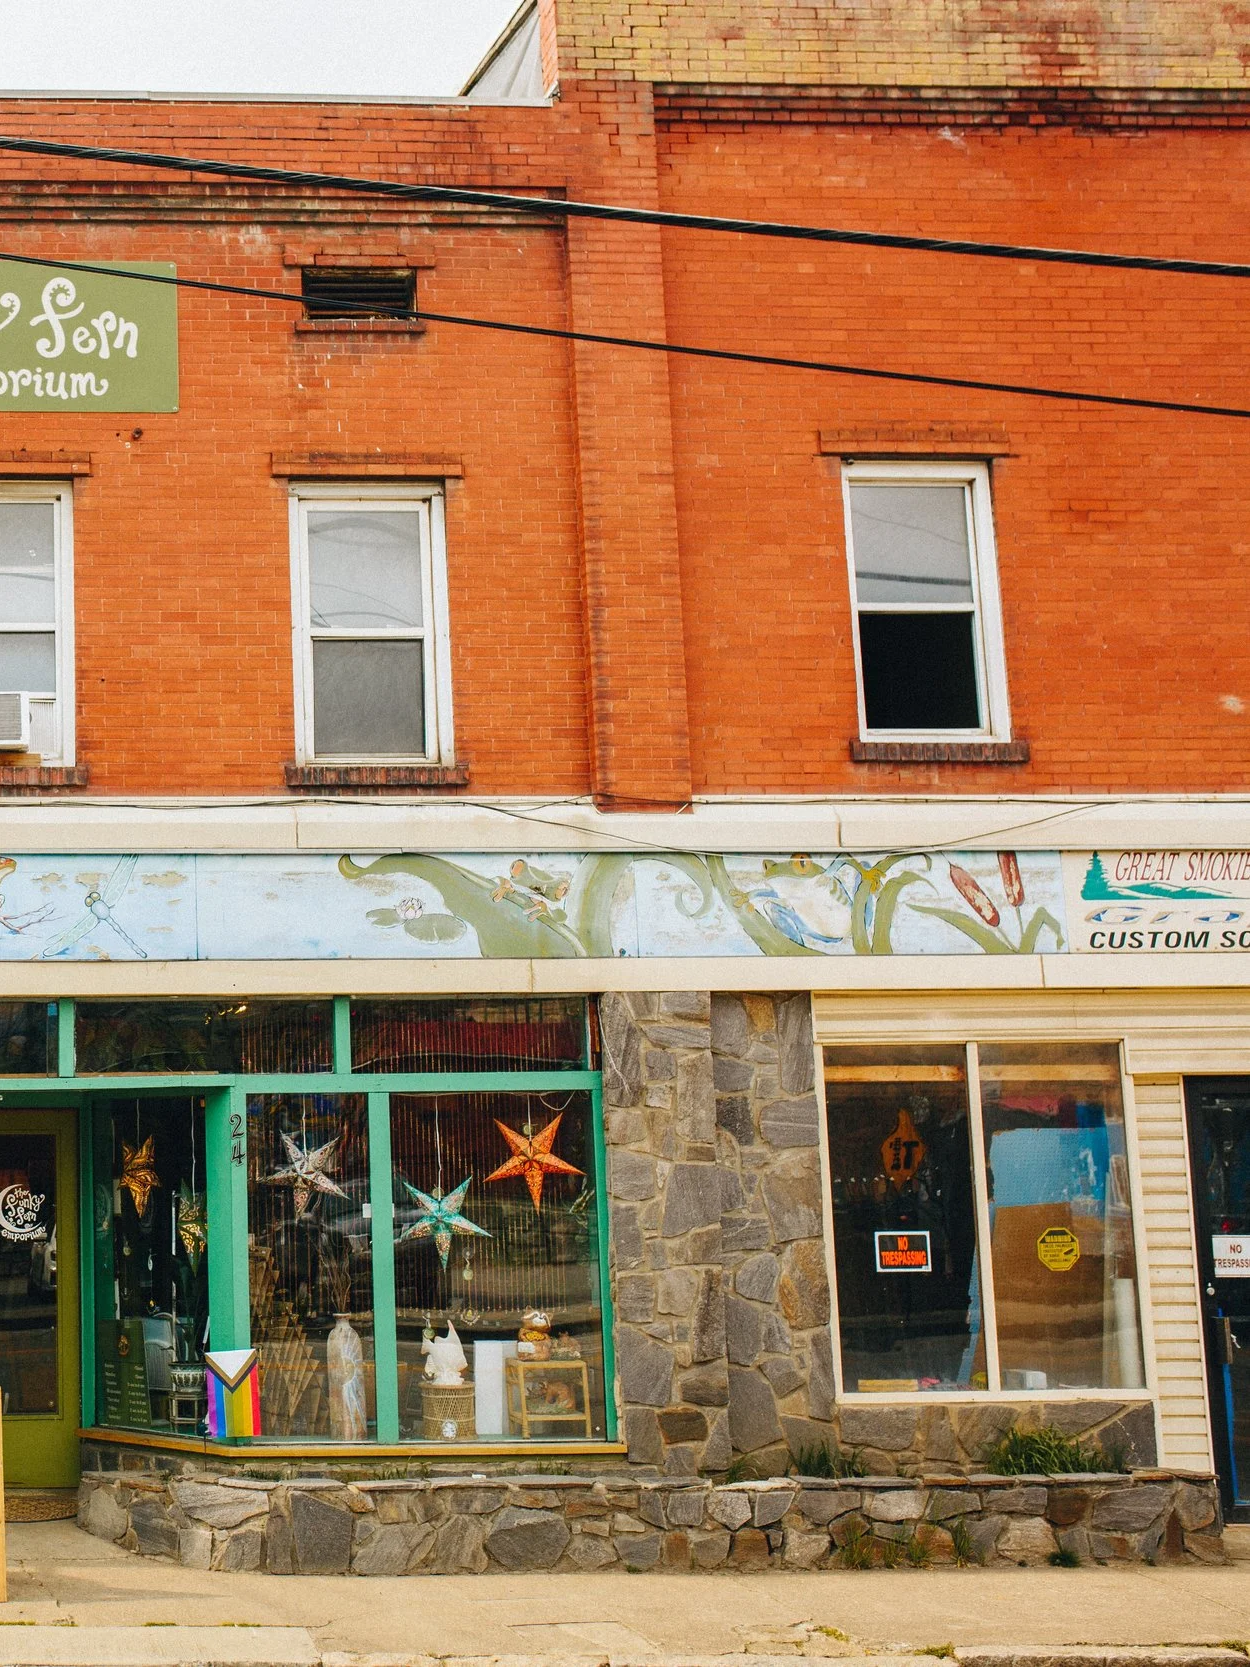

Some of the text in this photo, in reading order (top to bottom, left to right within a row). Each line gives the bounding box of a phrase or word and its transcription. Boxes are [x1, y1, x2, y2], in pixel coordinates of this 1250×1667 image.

[1115, 851, 1180, 881] GREAT
[1089, 930, 1210, 949] CUSTOM
[897, 1236, 909, 1251] NO
[1229, 1244, 1242, 1254] NO
[881, 1250, 927, 1266] TRESPASSING
[1214, 1258, 1250, 1268] TRESPASS
